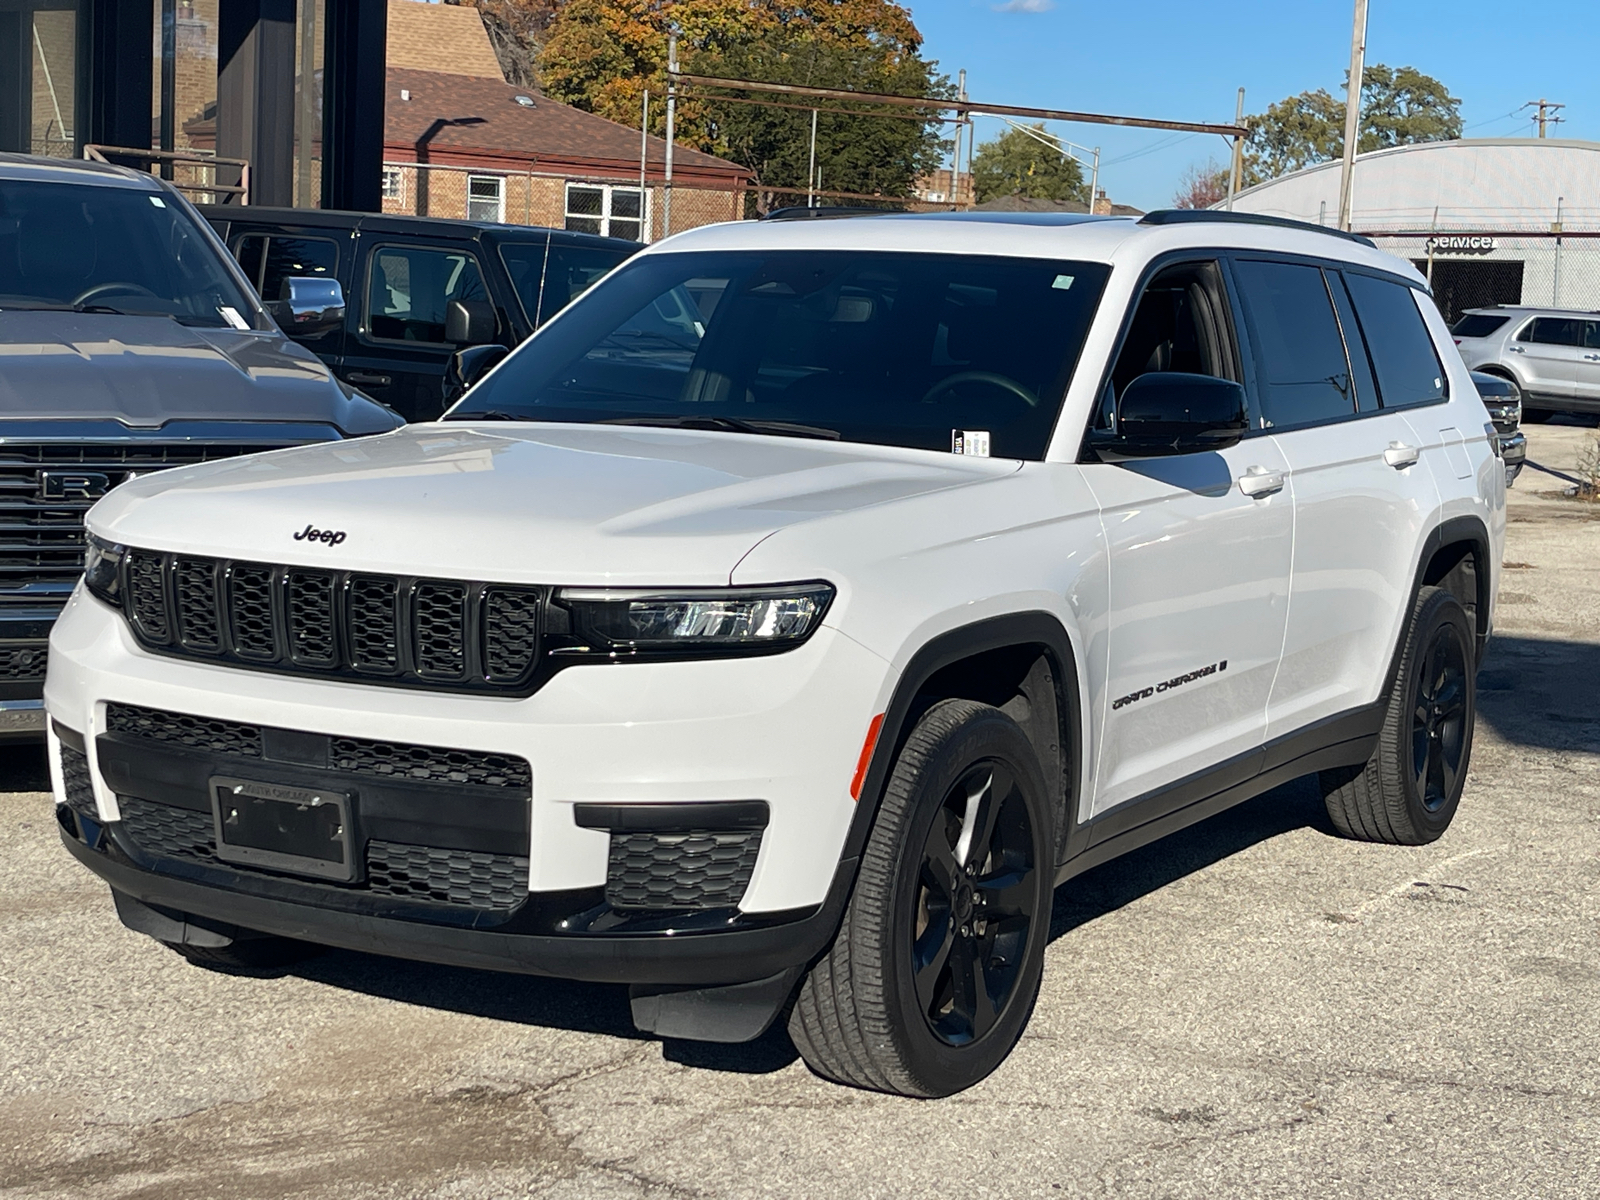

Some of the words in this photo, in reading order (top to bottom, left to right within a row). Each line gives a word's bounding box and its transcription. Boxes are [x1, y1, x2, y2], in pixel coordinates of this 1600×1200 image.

[293, 524, 347, 547] Jeep
[1112, 686, 1154, 710] GRAND
[1156, 663, 1217, 693] CHEROKEE
